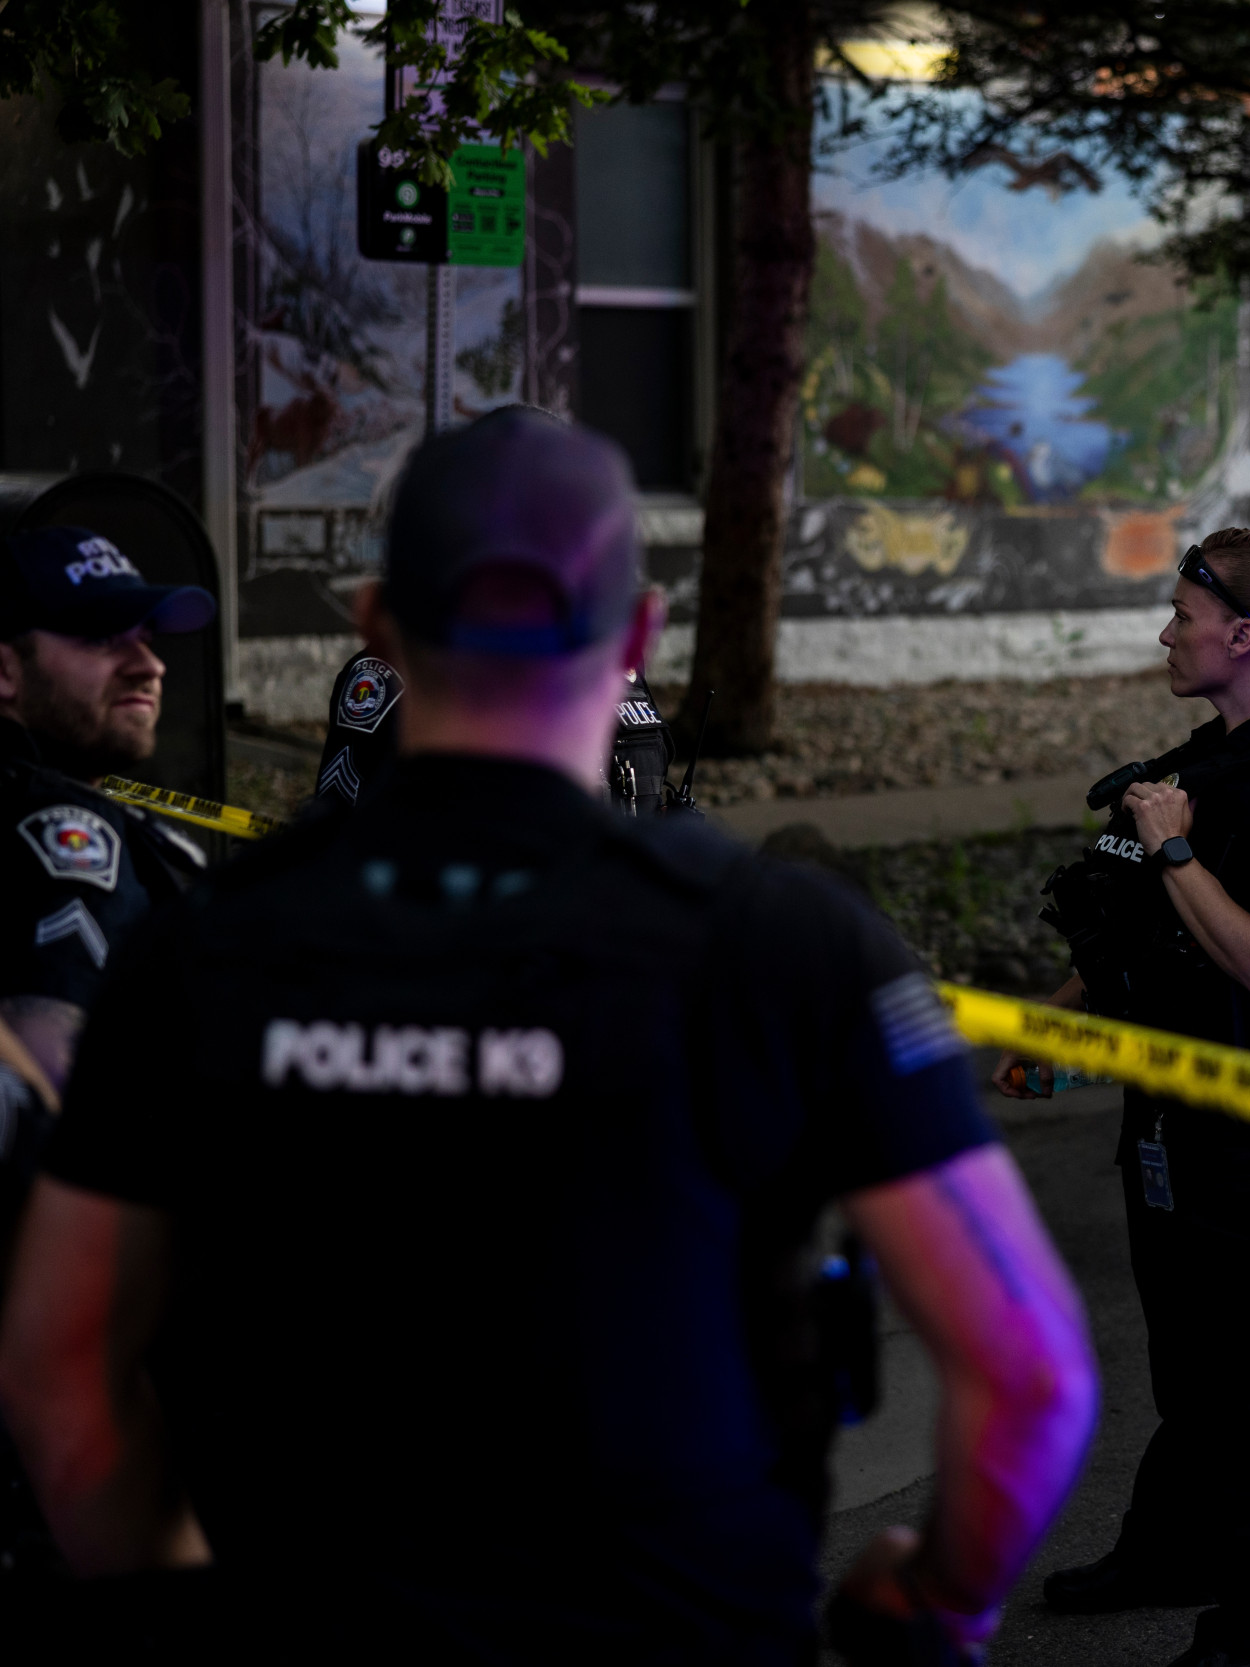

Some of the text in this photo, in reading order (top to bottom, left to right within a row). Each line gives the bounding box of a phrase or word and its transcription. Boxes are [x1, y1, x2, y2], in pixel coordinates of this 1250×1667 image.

[355, 660, 393, 680] POLICE
[614, 700, 661, 725] POLICE
[1094, 834, 1144, 863] POLICE
[261, 1018, 565, 1100] POLICE K9
